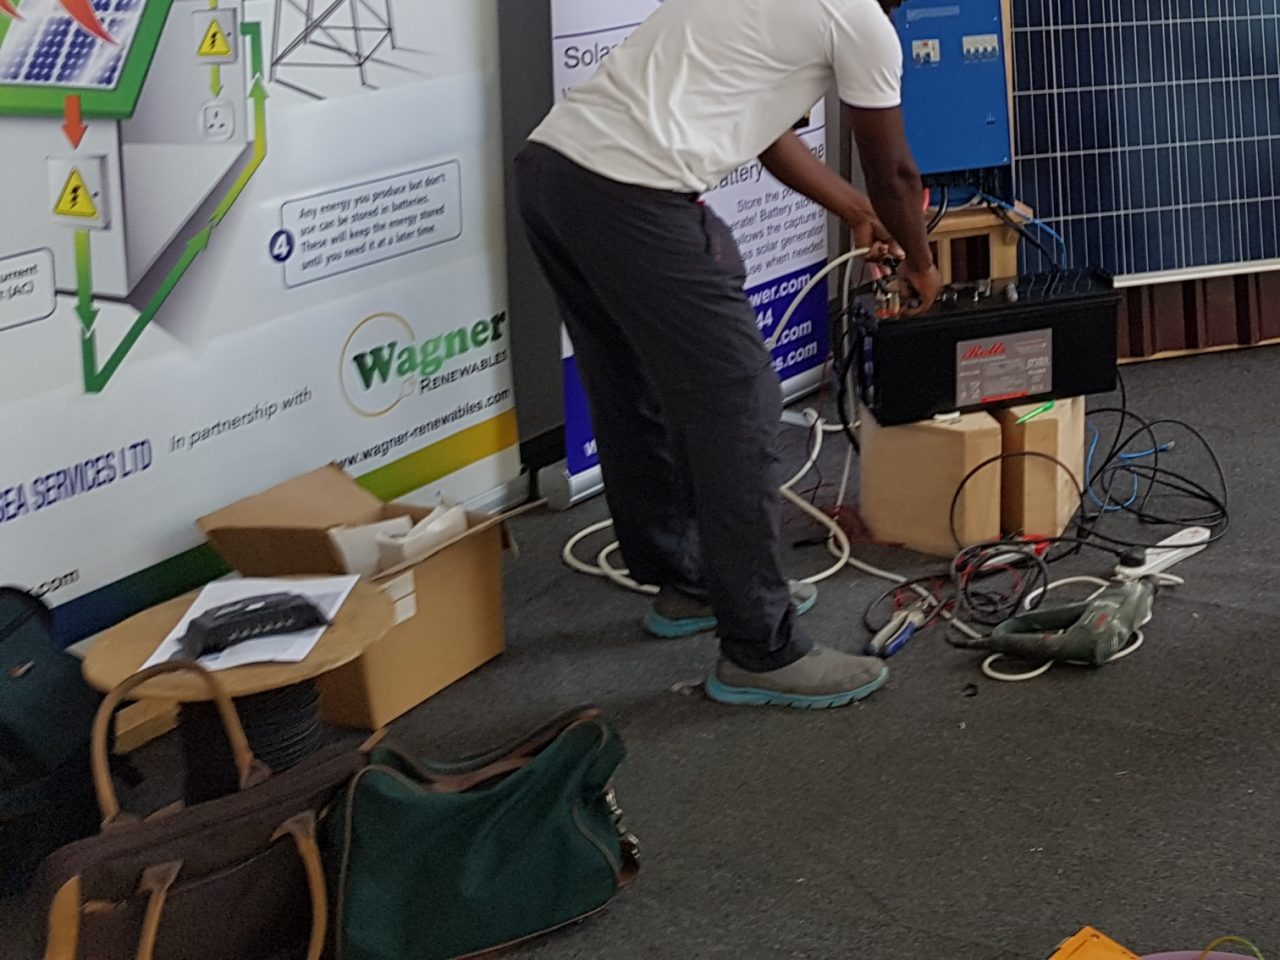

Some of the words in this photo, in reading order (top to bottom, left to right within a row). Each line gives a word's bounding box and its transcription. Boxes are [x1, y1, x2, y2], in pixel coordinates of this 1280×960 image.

[564, 42, 618, 69] Sola
[300, 207, 317, 220] Any
[320, 199, 352, 214] energy
[354, 194, 370, 208] you
[372, 186, 406, 203] produce
[409, 180, 422, 192] but
[425, 173, 446, 188] don't
[765, 190, 780, 203] the
[301, 225, 315, 237] use
[319, 220, 335, 232] can
[338, 215, 348, 227] be
[351, 207, 379, 222] stored
[381, 204, 389, 214] in
[301, 239, 327, 253] These
[331, 231, 346, 243] will
[350, 225, 370, 240] keep
[373, 219, 386, 231] the
[388, 213, 417, 228] energy
[420, 204, 445, 219] stored
[767, 224, 781, 235] the
[784, 212, 817, 230] capture
[272, 233, 290, 258] 4
[302, 256, 322, 271] until
[325, 252, 342, 266] you
[345, 243, 365, 257] need
[396, 229, 415, 244] later
[353, 311, 506, 390] Wagner
[420, 349, 508, 394] RENEWABLES
[169, 435, 185, 453] In
[189, 401, 278, 451] partnership
[281, 386, 312, 411] with
[335, 388, 510, 470] ww.wagner-renewables.com
[31, 450, 117, 511] SERVICES
[119, 439, 152, 478] LTD
